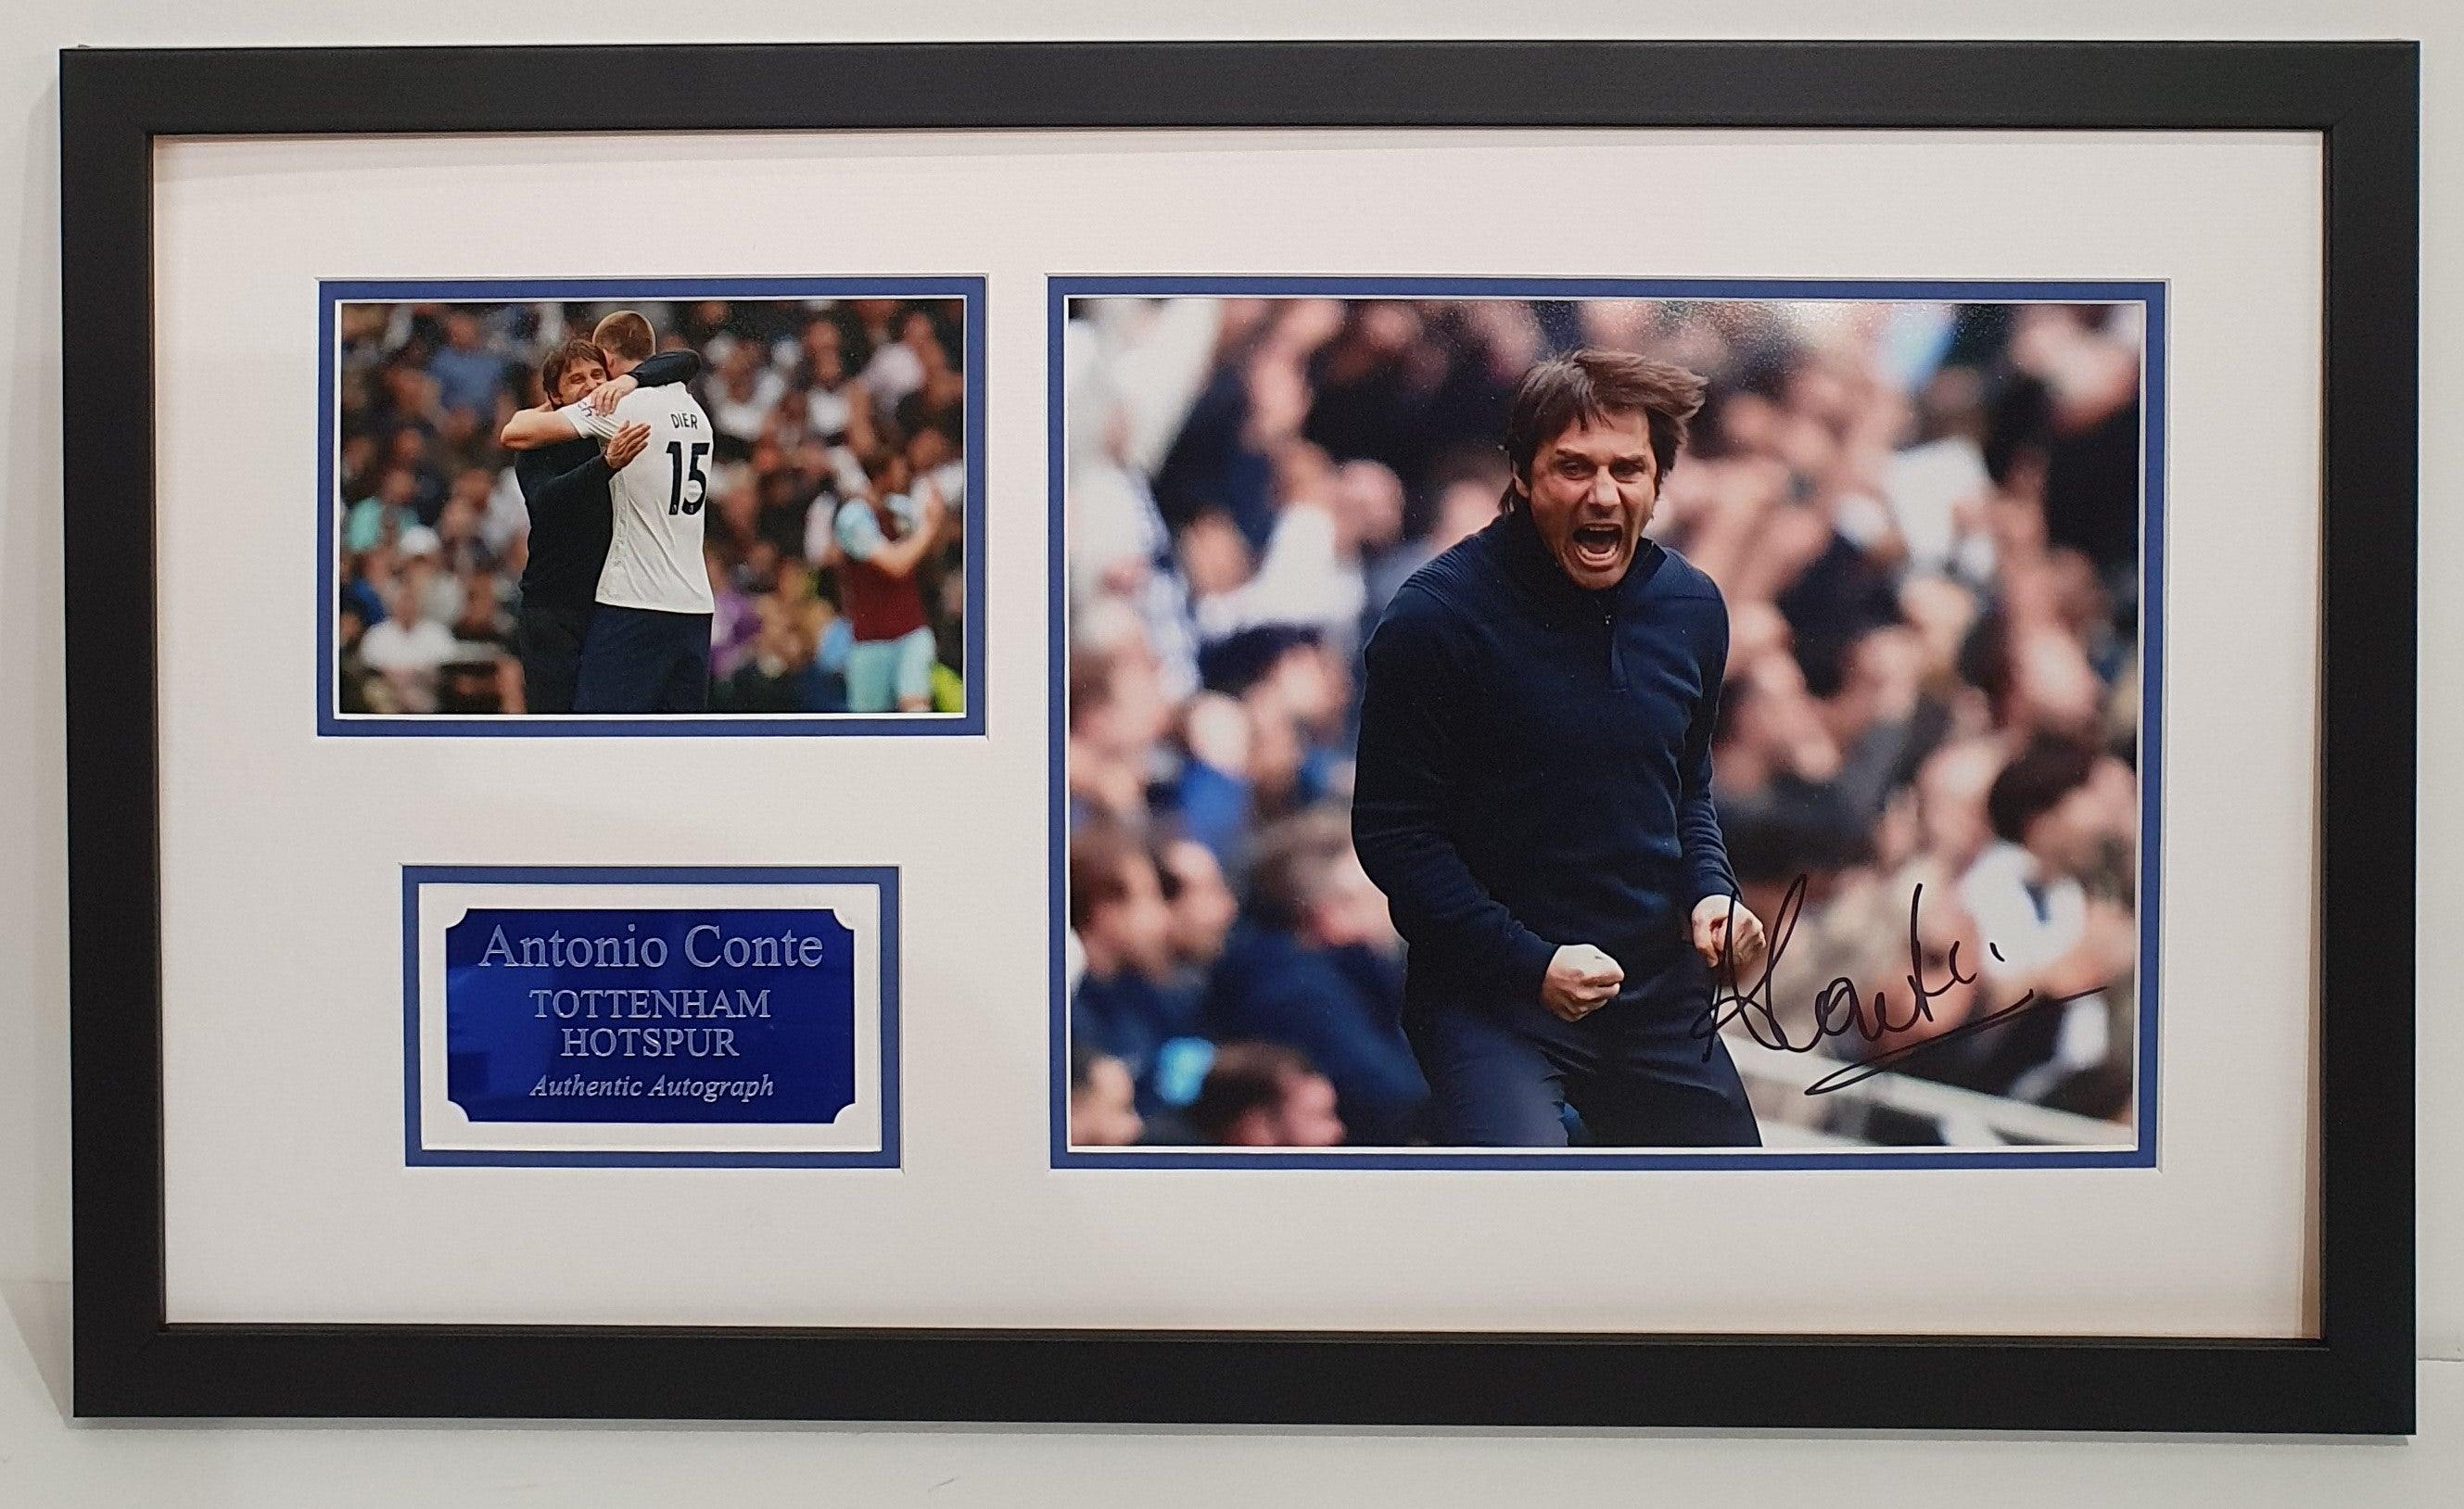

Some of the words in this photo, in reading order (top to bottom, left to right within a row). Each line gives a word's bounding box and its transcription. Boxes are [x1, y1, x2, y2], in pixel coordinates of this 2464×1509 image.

[670, 412, 698, 429] DIER
[666, 440, 710, 515] 15
[478, 923, 667, 968] Antonio
[684, 925, 823, 968] Conte
[529, 989, 770, 1019] TOTTENHAM
[560, 1028, 740, 1058] HOTSPUR
[529, 1074, 642, 1098] Authentic
[647, 1075, 774, 1103] Autograph
